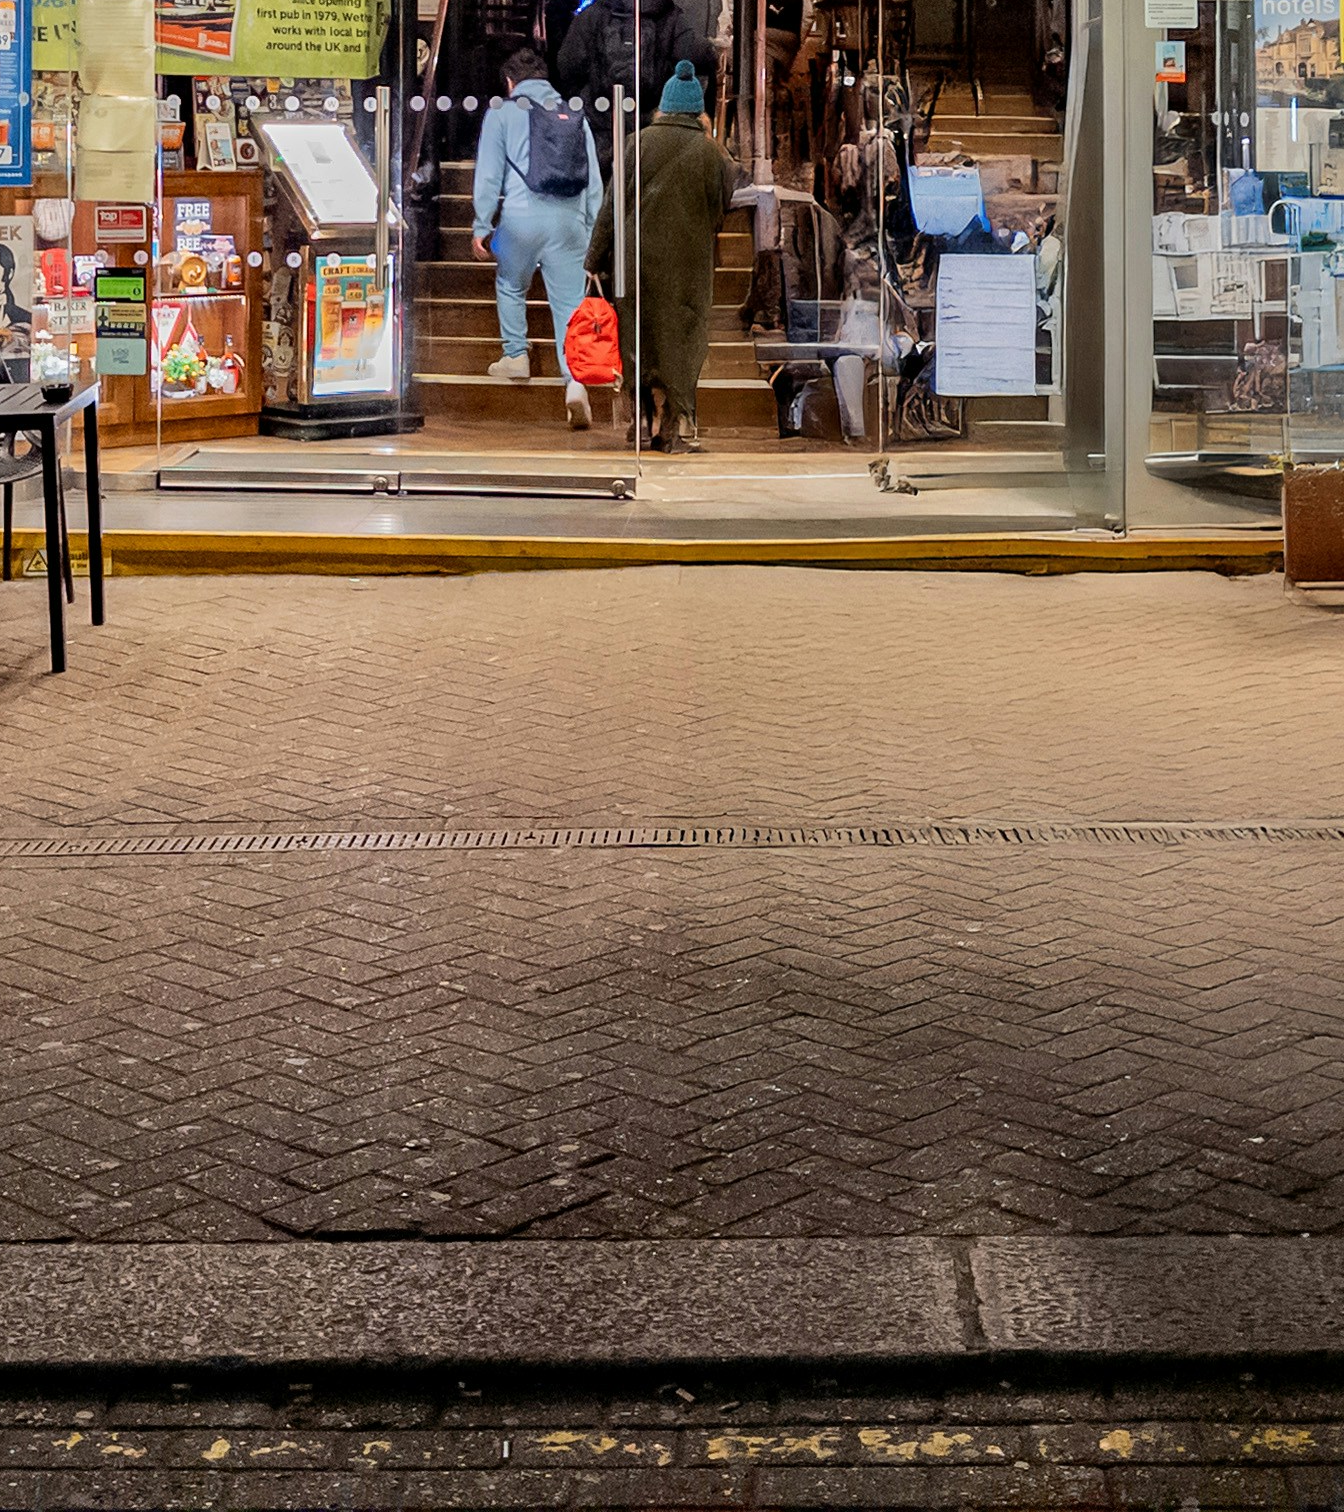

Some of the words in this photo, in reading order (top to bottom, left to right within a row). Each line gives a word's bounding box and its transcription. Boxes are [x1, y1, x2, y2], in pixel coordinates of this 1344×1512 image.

[257, 8, 277, 19] first
[280, 10, 300, 20] pub
[302, 11, 311, 19] in
[273, 26, 302, 36] works
[305, 26, 326, 36] with
[330, 27, 353, 37] local
[266, 41, 303, 51] around
[305, 42, 322, 52] the
[325, 42, 341, 51] UK
[343, 44, 361, 52] and
[176, 203, 209, 218] FREE
[323, 266, 350, 276] CRAFT
